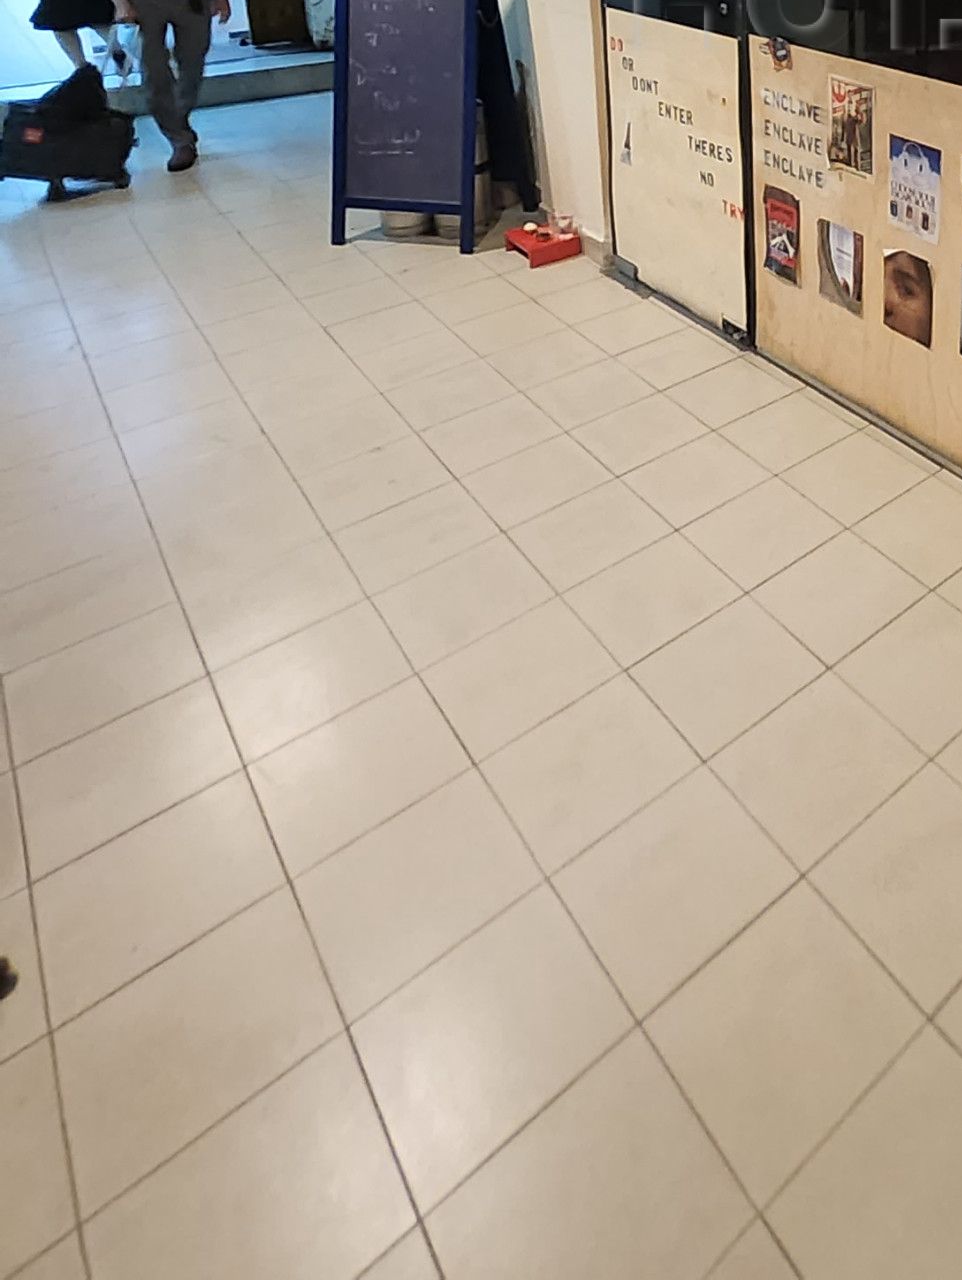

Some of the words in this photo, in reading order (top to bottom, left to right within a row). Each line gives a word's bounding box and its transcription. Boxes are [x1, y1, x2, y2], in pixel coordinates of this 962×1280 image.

[610, 36, 624, 52] DO
[622, 56, 635, 71] OR
[632, 76, 659, 96] DONT
[658, 101, 694, 126] ENTER
[763, 87, 822, 124] ENCLAVE
[687, 135, 734, 163] THERES
[763, 119, 823, 156] ENCLAVE
[700, 171, 715, 187] NO
[763, 149, 825, 189] ENCLAVE
[721, 199, 747, 220] TRY
